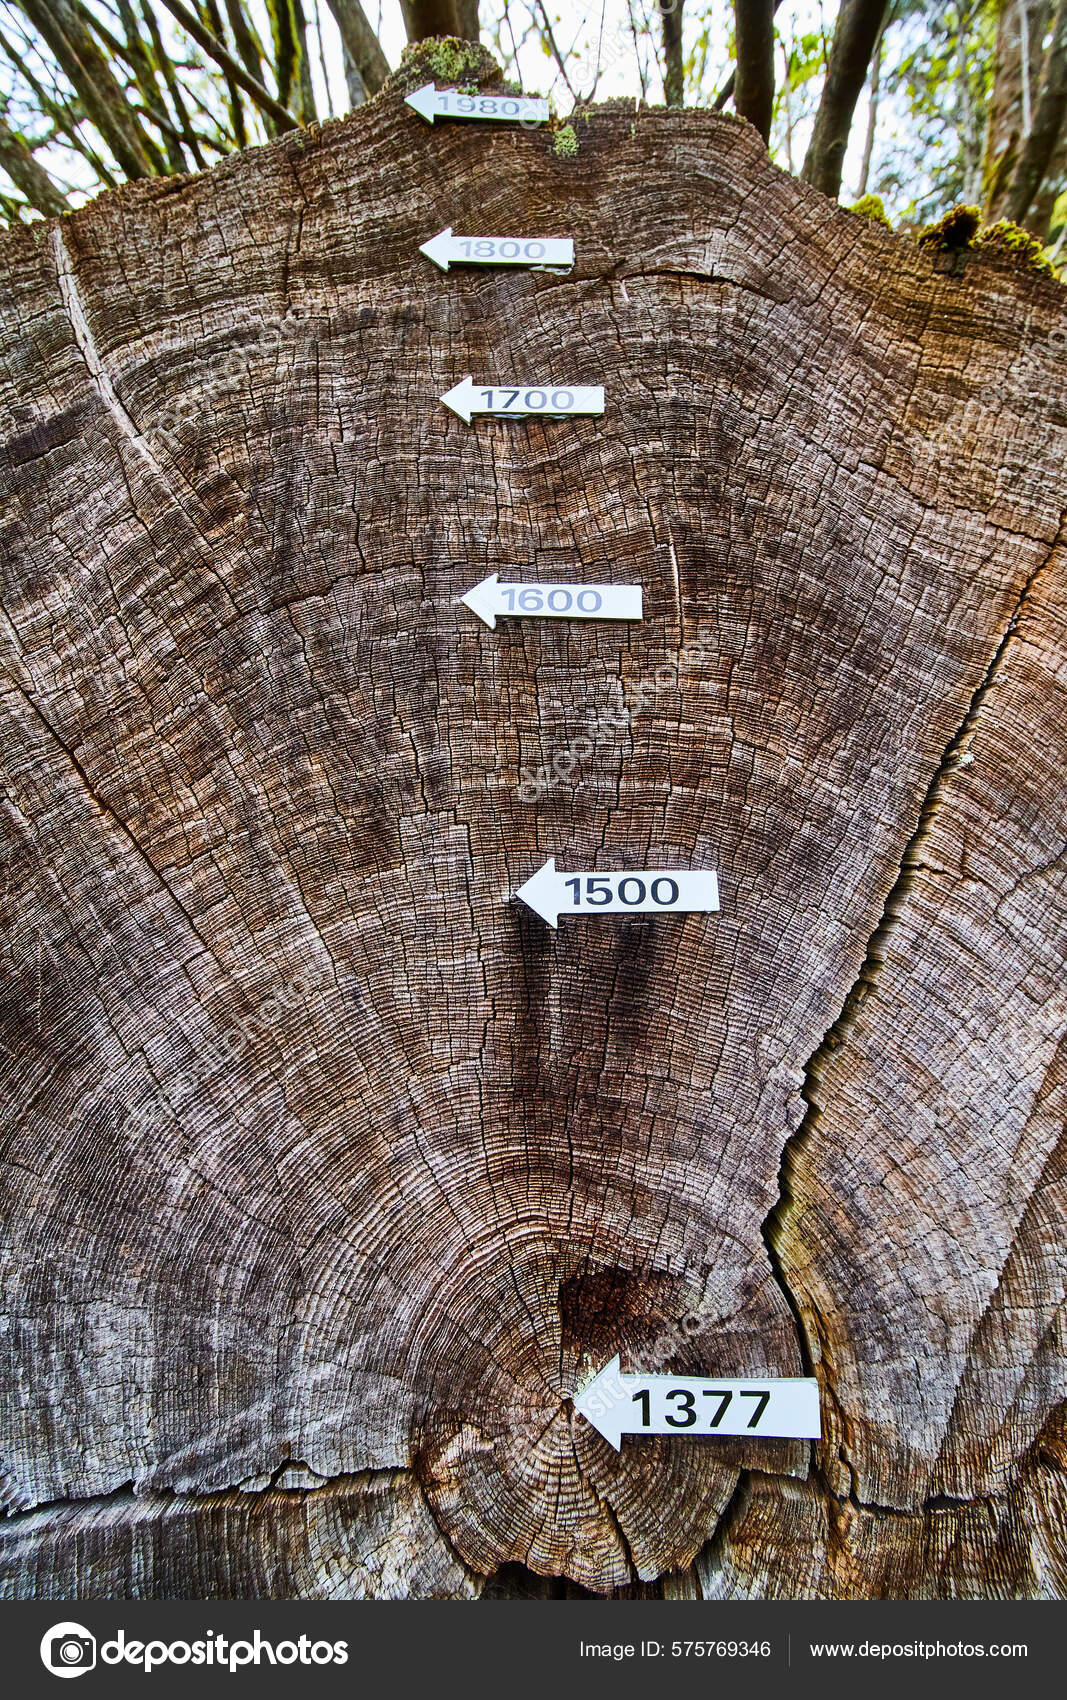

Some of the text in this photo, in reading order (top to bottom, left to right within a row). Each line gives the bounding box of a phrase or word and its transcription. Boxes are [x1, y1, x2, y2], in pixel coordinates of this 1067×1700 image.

[438, 96, 520, 116] 1980
[459, 240, 546, 258] 1800
[480, 390, 575, 410] 1700
[501, 588, 602, 613] 1600
[564, 877, 680, 906] 1500
[632, 1389, 771, 1429] 1377
